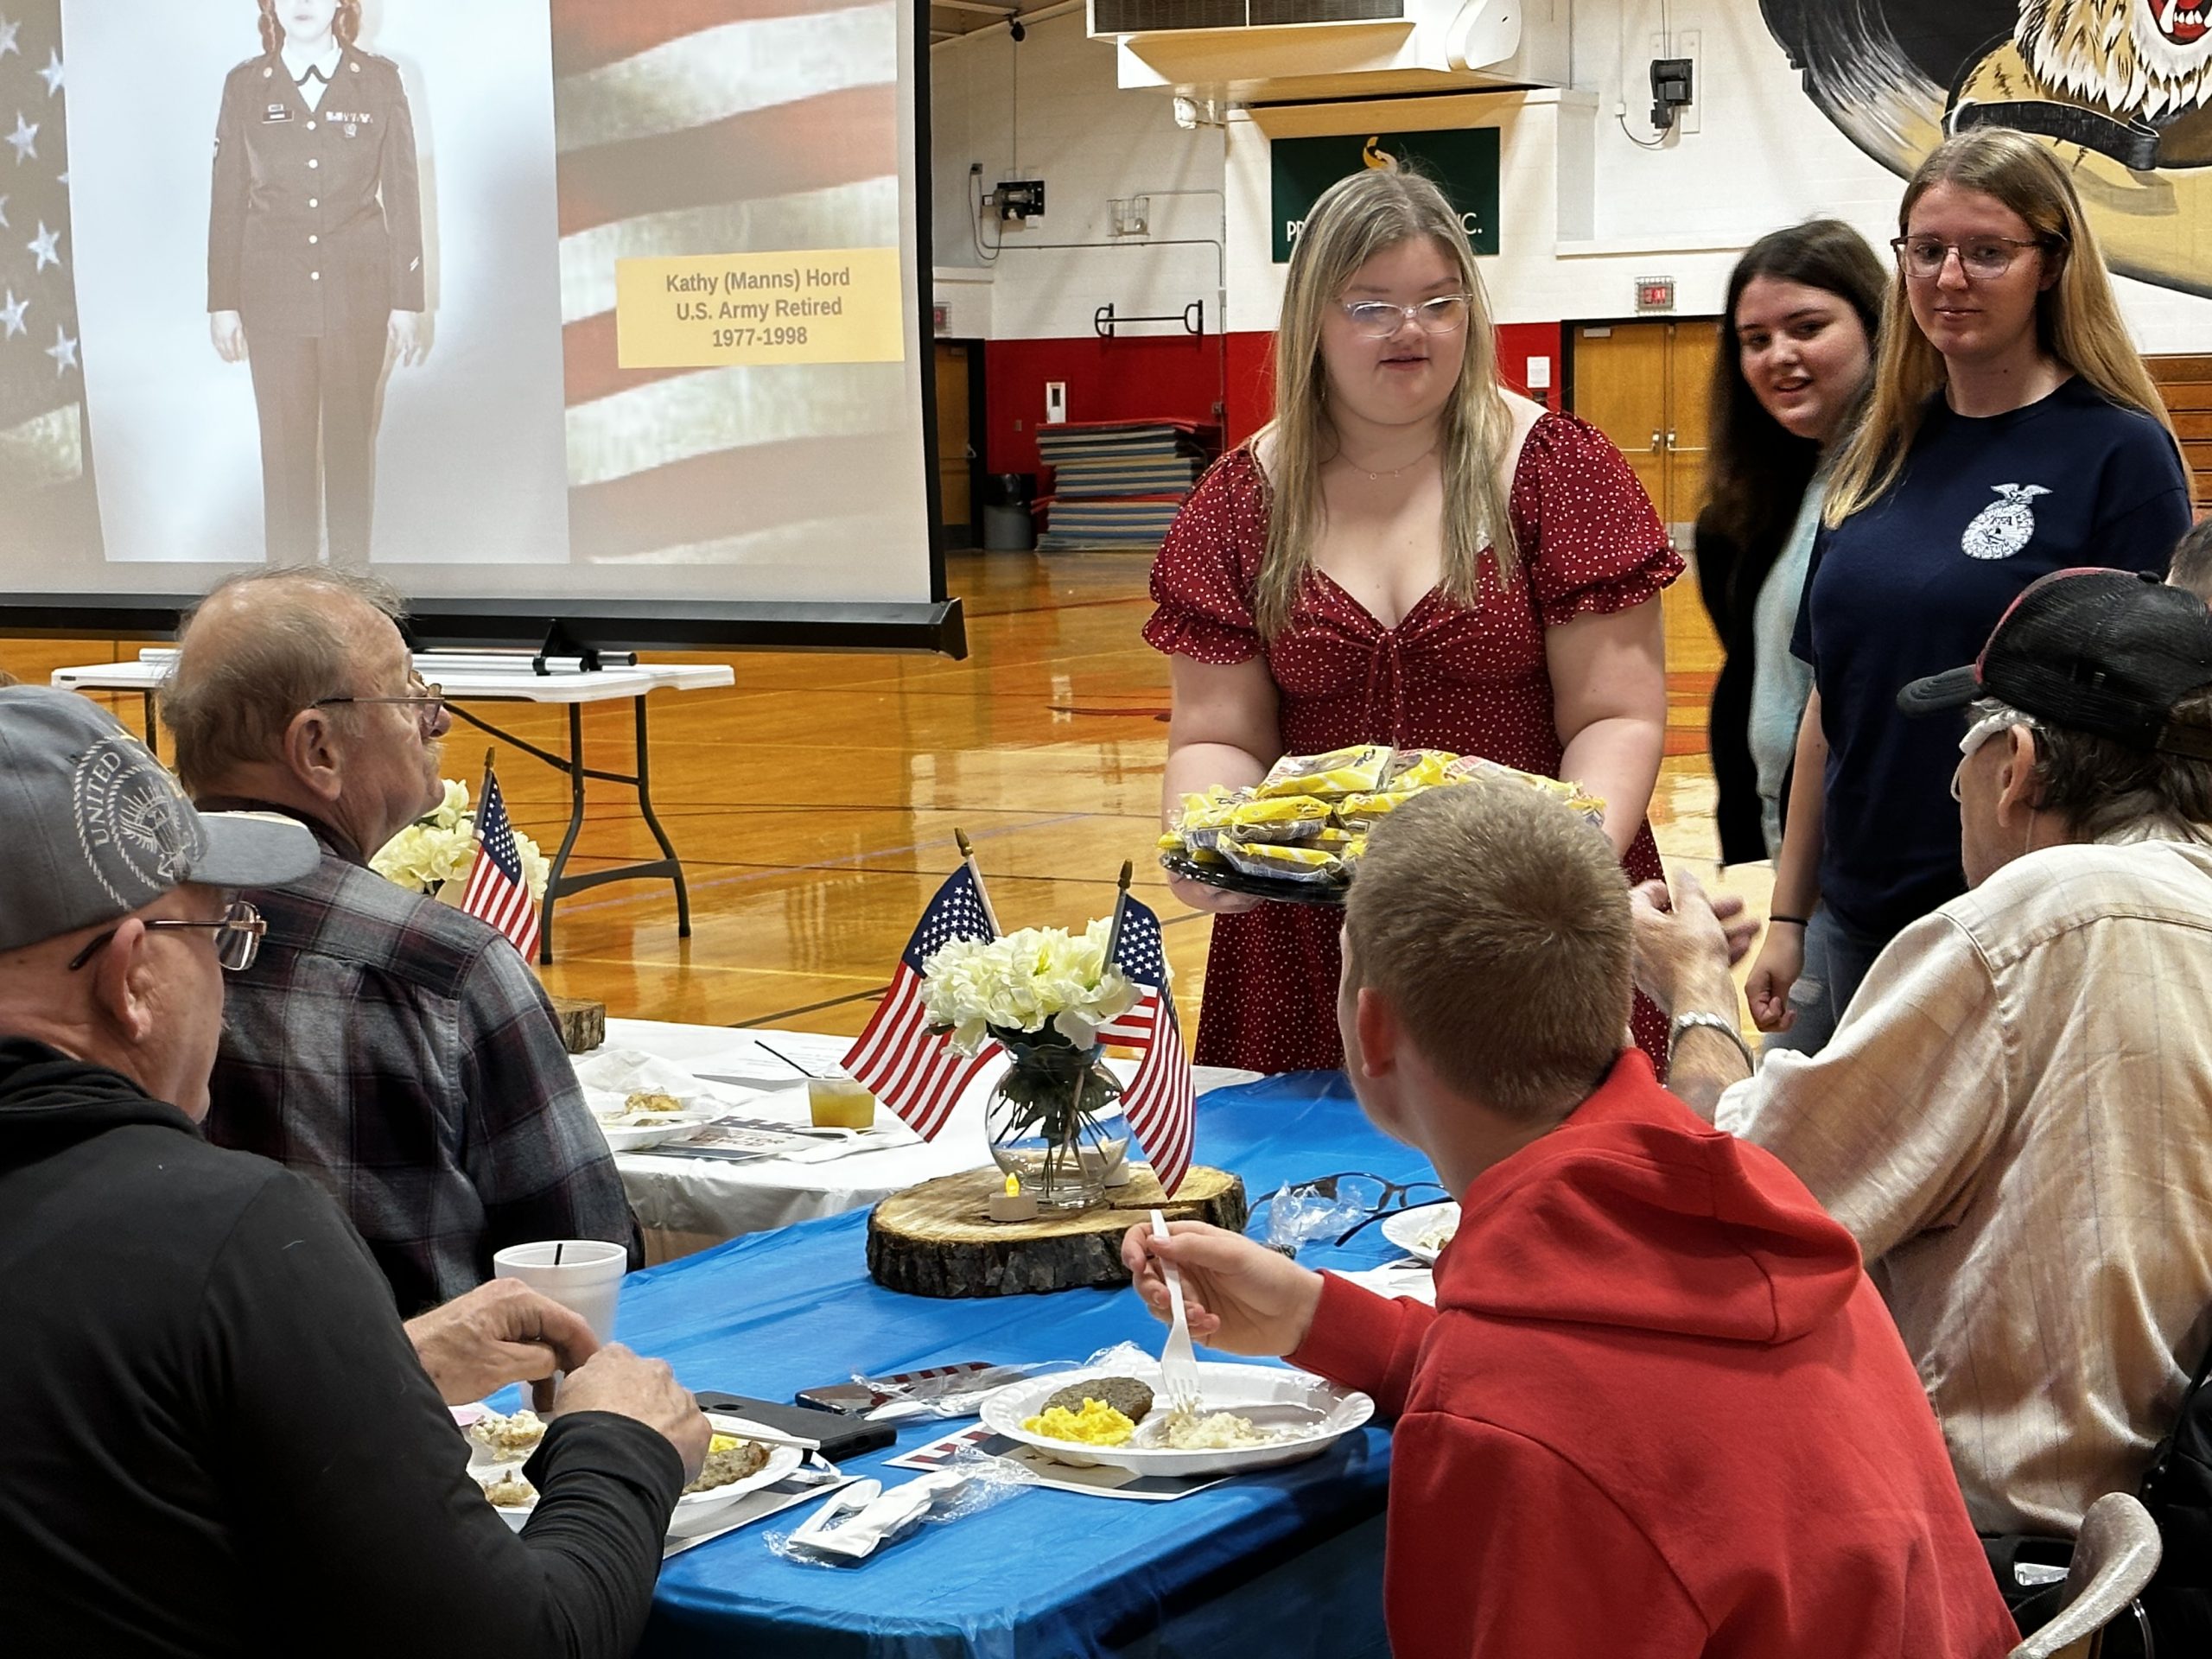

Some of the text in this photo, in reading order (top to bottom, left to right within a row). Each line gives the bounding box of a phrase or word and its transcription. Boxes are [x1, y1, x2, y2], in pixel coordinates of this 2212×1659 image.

[665, 267, 850, 295] Kathy (Manns) Hord
[677, 297, 842, 322] U.S. Army Retired
[712, 327, 808, 347] 1977-1998
[86, 751, 122, 846] UNITED
